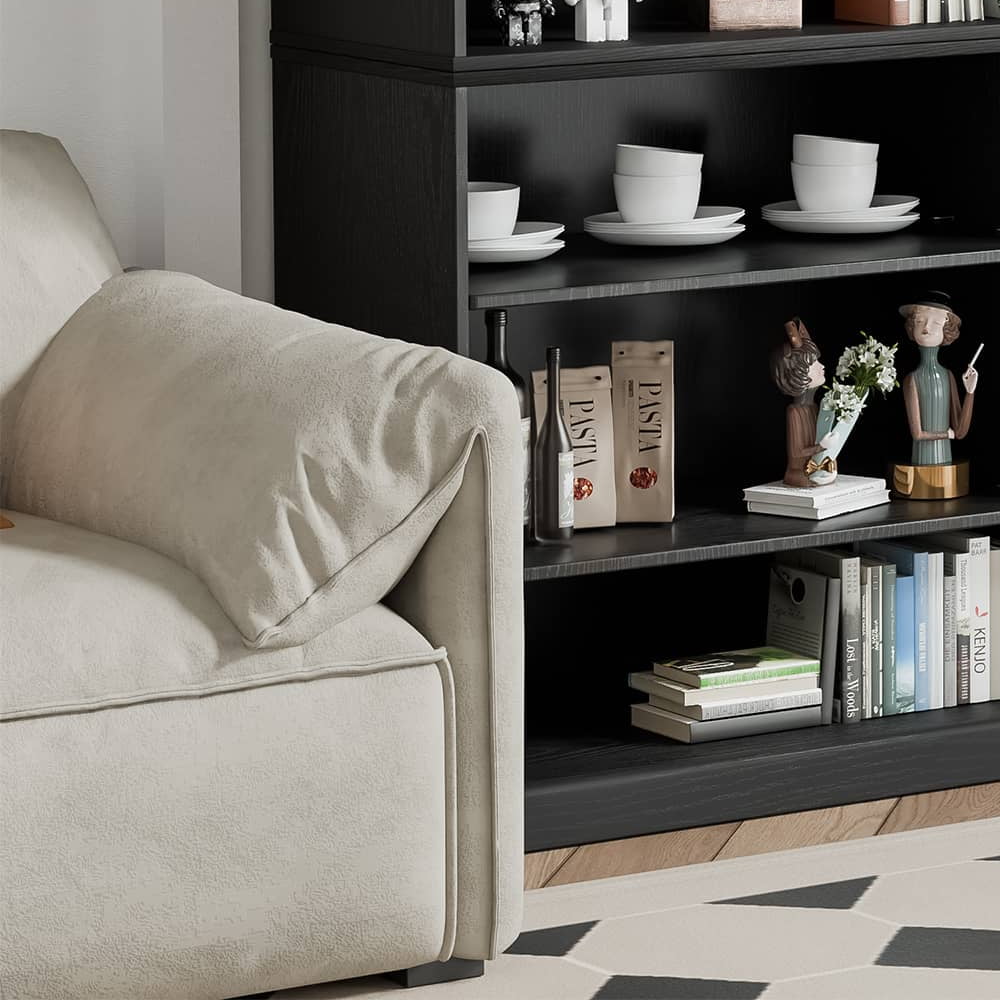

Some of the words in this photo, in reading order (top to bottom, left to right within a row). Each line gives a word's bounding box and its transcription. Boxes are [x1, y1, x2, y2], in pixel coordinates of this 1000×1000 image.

[569, 400, 597, 467] PASTA
[639, 382, 663, 453] PASTA
[846, 638, 859, 663] Lost
[974, 628, 986, 674] KENJO
[846, 678, 860, 718] Woods
